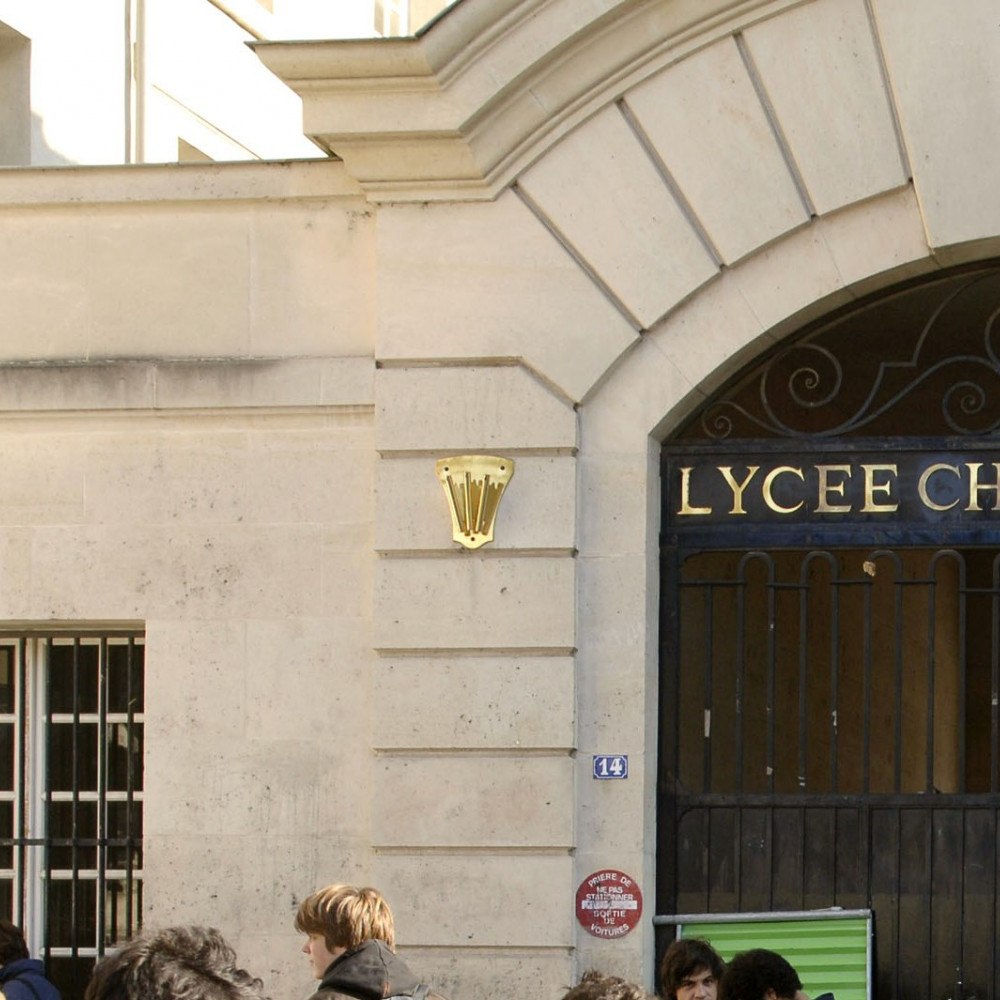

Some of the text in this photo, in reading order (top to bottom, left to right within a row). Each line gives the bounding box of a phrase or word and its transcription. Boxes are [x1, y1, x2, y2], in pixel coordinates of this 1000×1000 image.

[677, 463, 899, 515] LYCEE
[599, 758, 622, 775] 14
[588, 873, 632, 887] PRIERE DE
[591, 924, 629, 936] VOITURES
